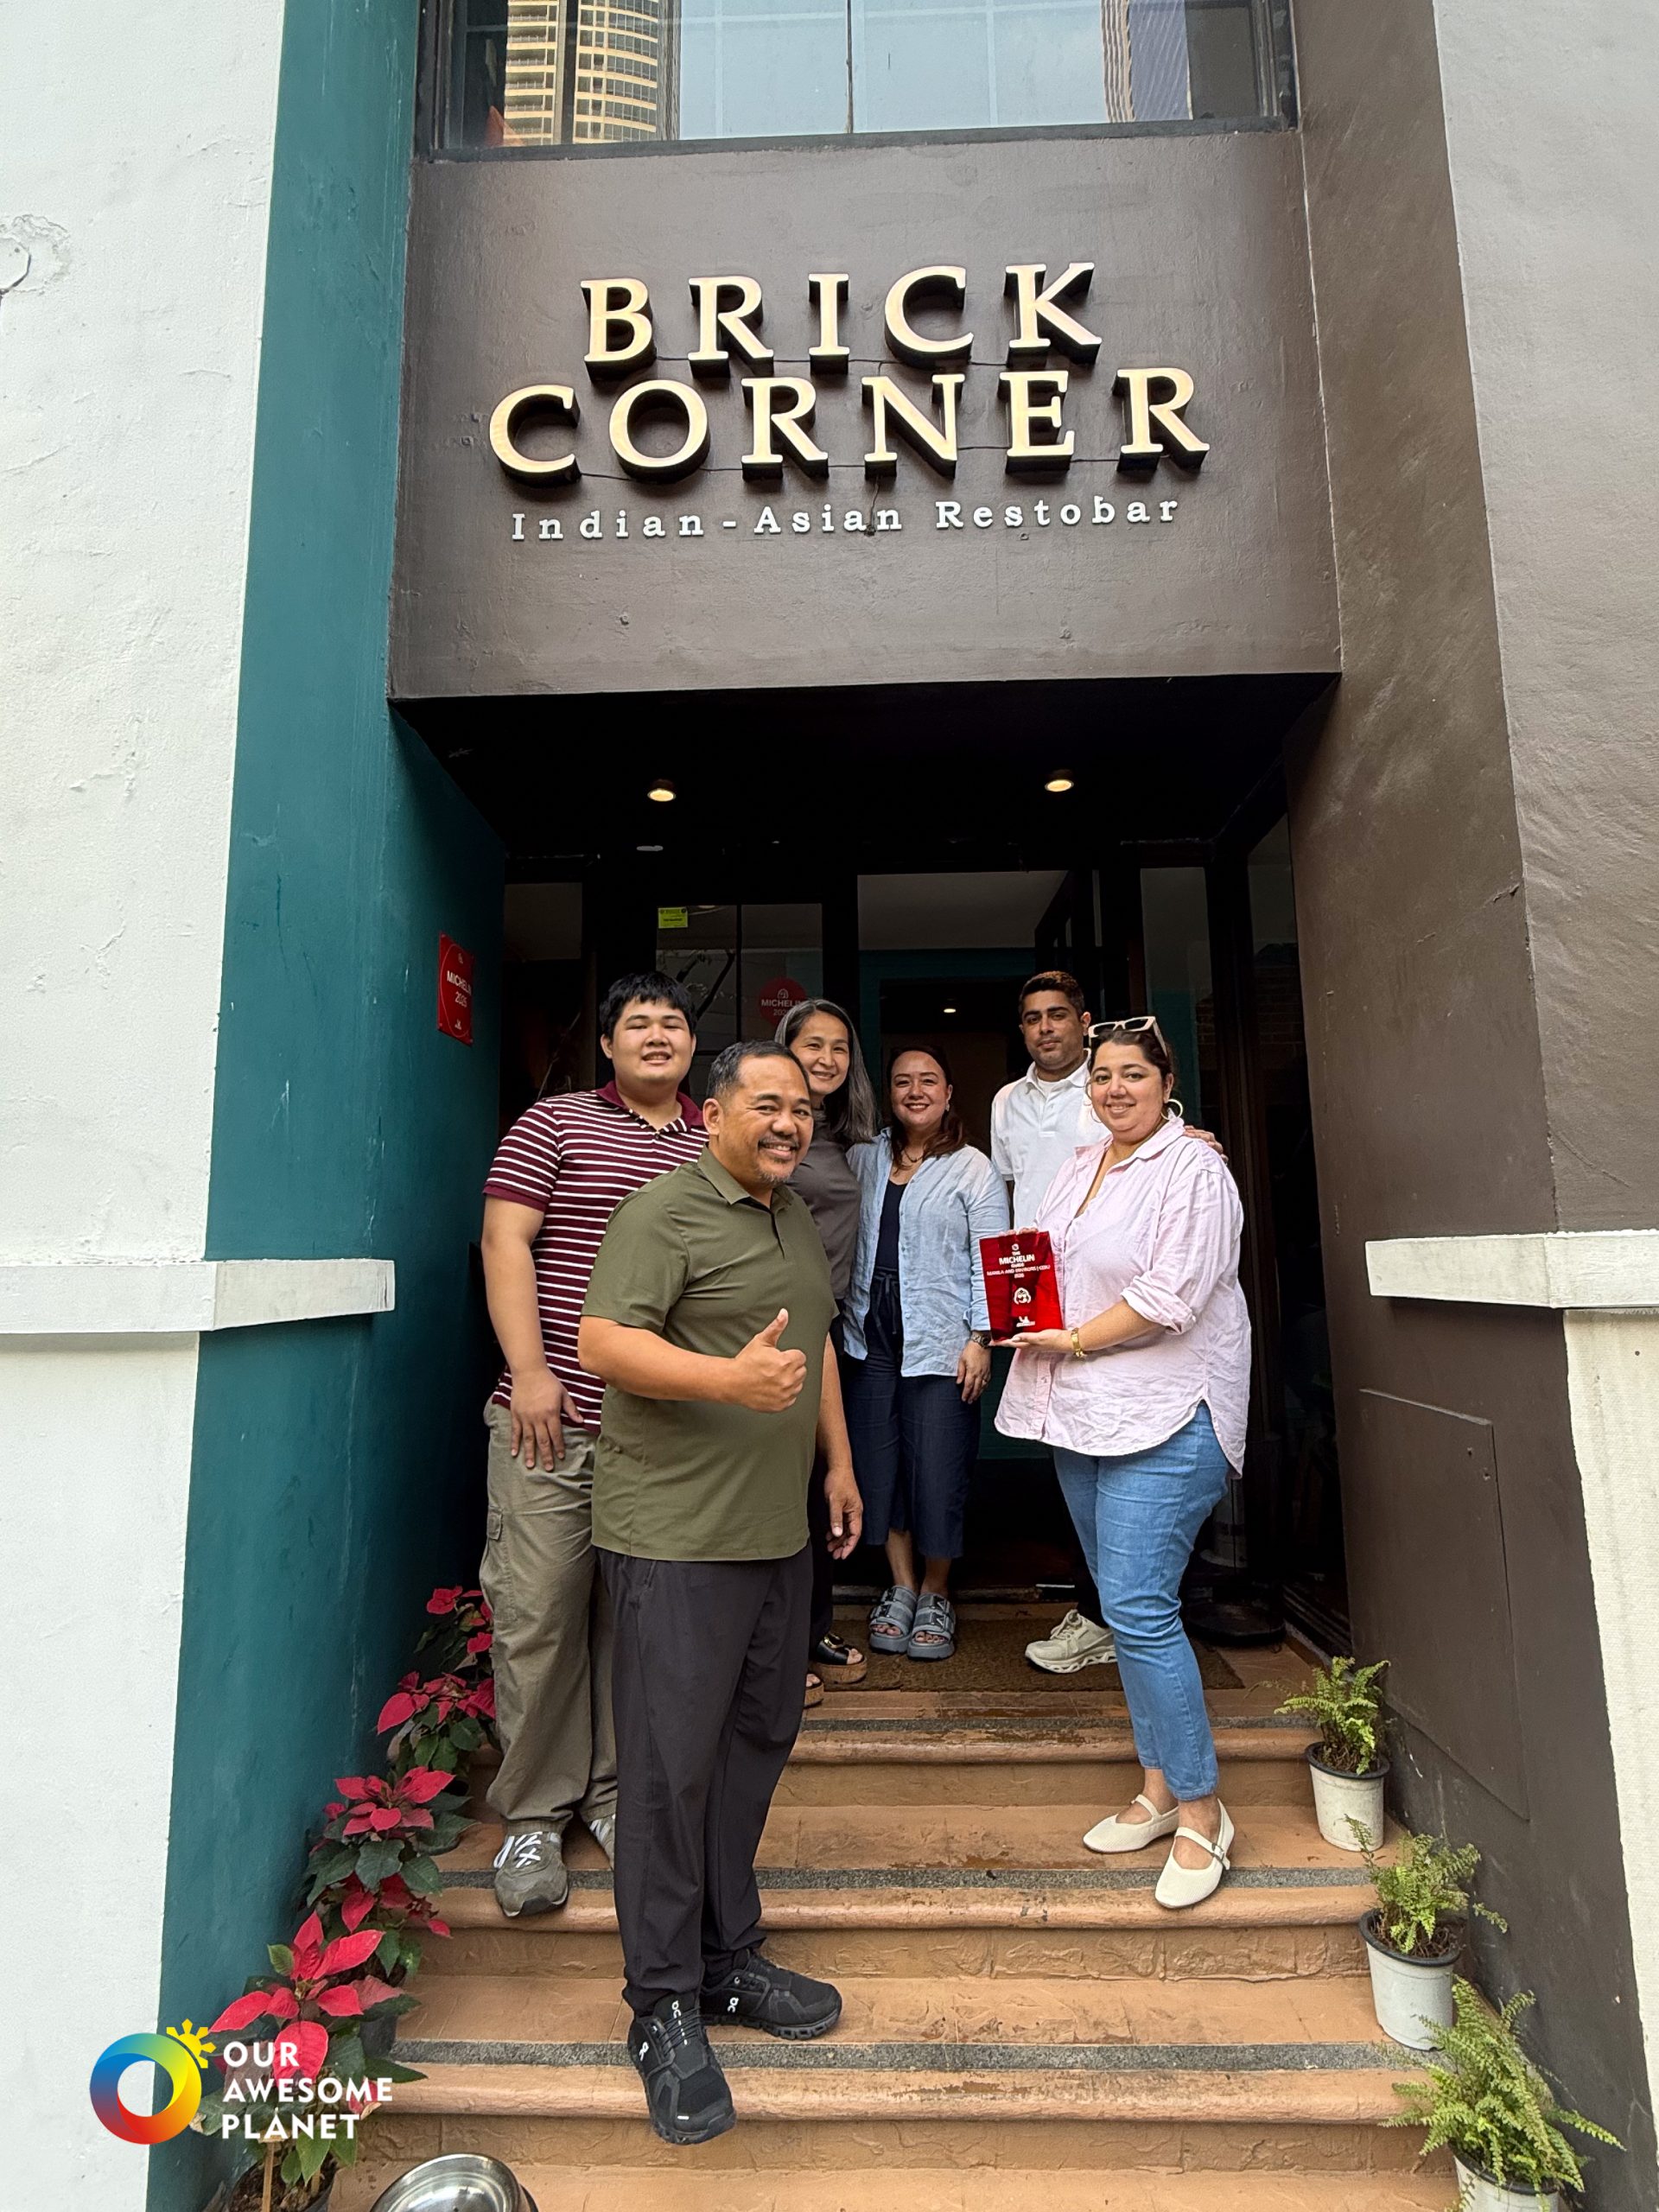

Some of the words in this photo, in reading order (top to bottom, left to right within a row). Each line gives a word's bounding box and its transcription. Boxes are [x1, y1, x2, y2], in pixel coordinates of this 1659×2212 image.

[581, 262, 1103, 364] BRICK
[489, 367, 1210, 476] CORNER
[936, 496, 1178, 530] Restobar
[999, 1254, 1035, 1265] MICHELIN
